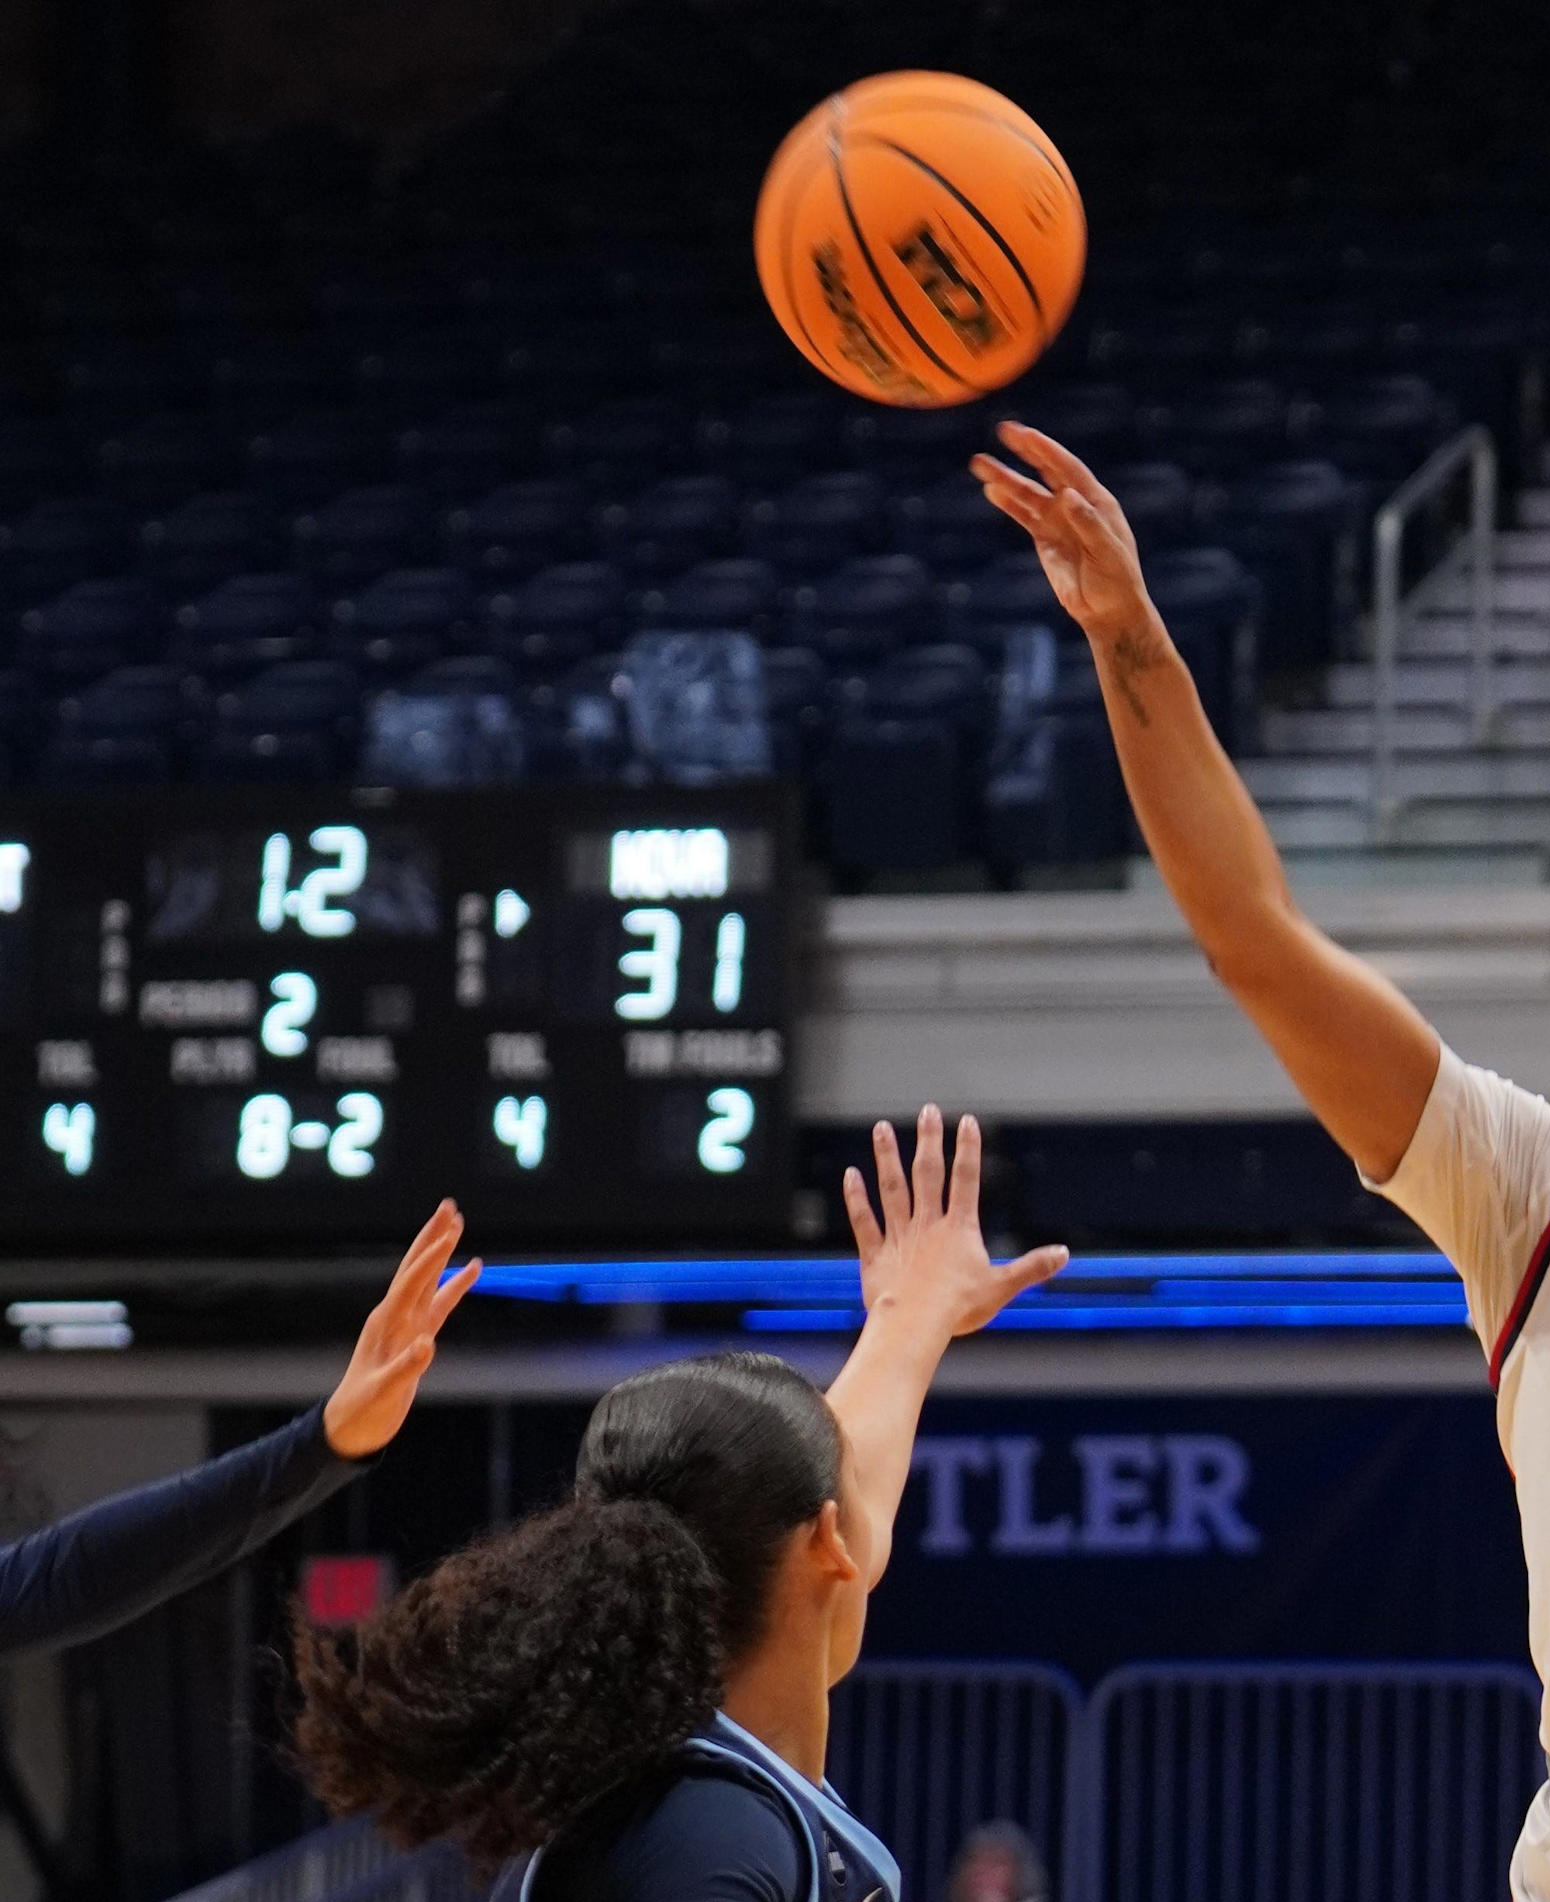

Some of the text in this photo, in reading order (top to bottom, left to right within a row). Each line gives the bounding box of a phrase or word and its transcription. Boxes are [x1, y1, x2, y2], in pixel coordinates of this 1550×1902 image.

[613, 908, 746, 1021] 31
[261, 972, 318, 1058] 2
[42, 1102, 96, 1176] 4
[236, 1092, 384, 1180] 8-2
[493, 1095, 548, 1170] 4
[696, 1087, 756, 1174] 2
[911, 1434, 1257, 1552] TLER
